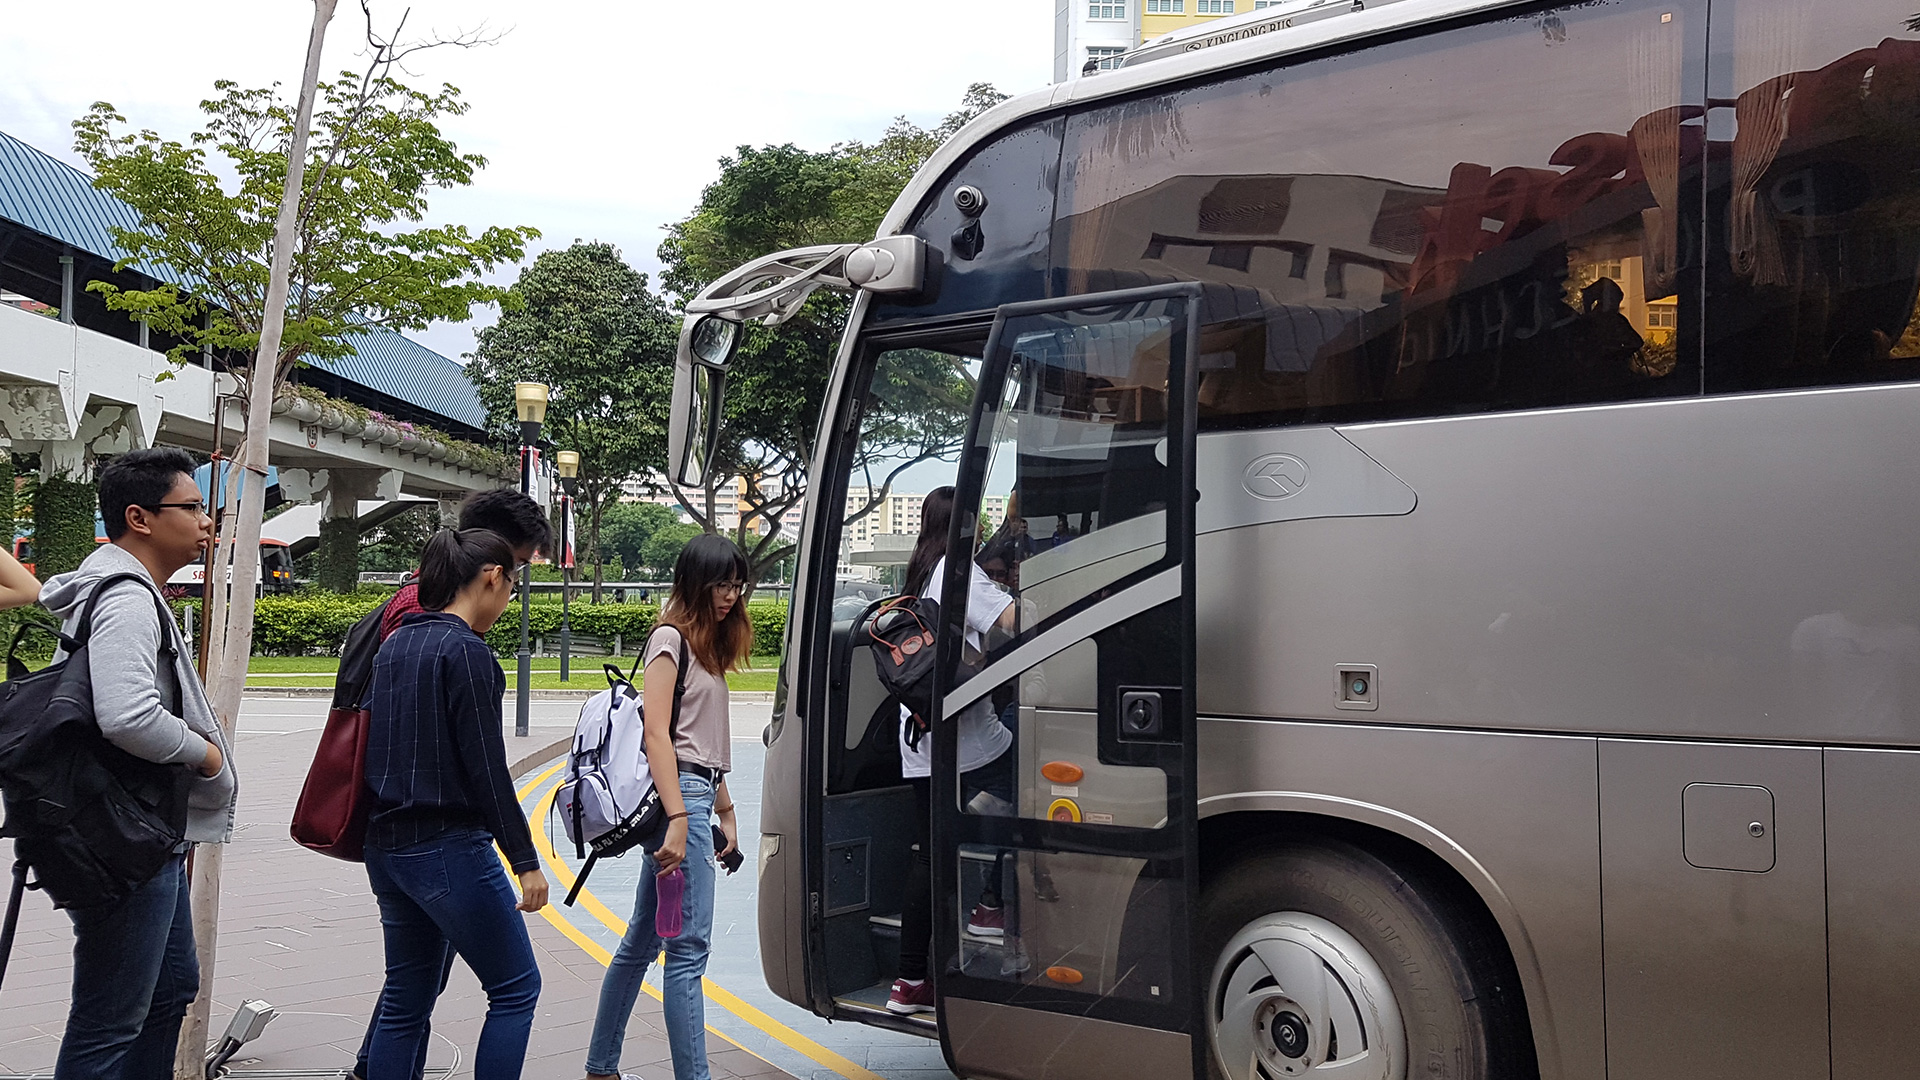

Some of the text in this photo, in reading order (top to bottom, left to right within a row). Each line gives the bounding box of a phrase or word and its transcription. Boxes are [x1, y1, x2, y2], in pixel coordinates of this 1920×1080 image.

[192, 570, 205, 580] SB
[629, 805, 650, 828] FILA
[647, 790, 659, 804] FIL
